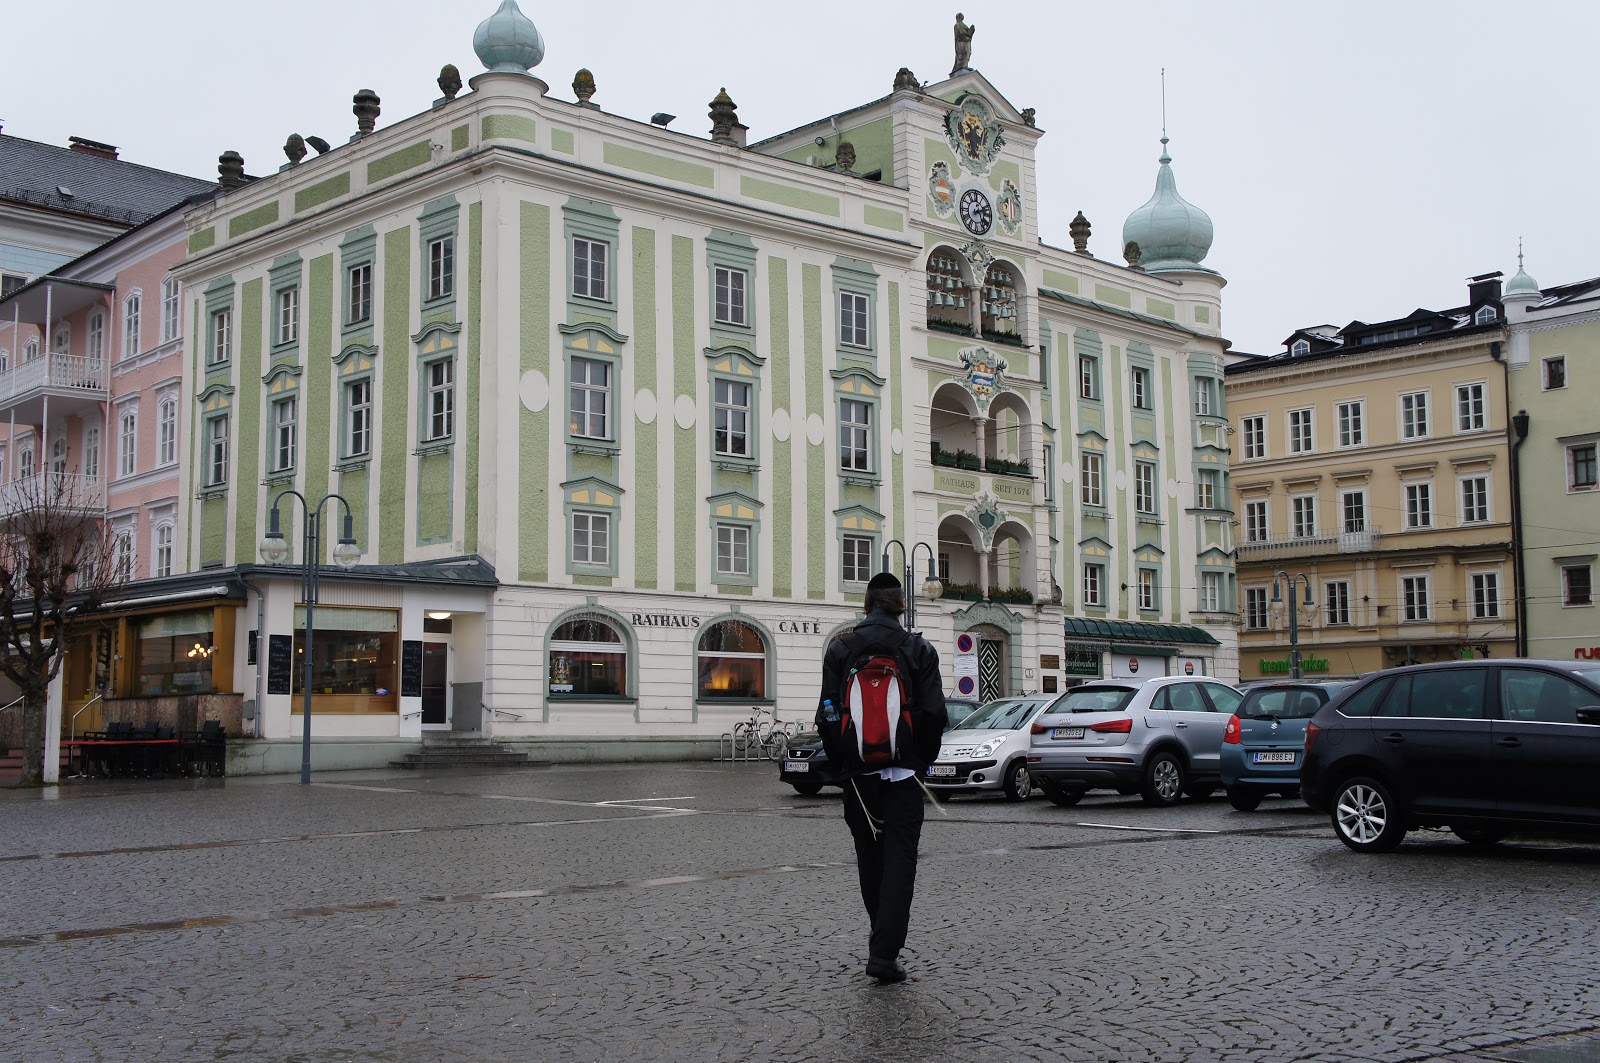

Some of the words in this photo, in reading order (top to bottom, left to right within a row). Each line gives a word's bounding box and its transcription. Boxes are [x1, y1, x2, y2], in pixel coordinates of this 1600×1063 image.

[940, 476, 975, 489] RATHAUS
[994, 483, 1012, 494] SEIT
[1013, 487, 1030, 496] 1574
[631, 613, 700, 628] RATHAUS
[779, 619, 821, 634] CAFÉ
[1260, 652, 1329, 673] trendaker
